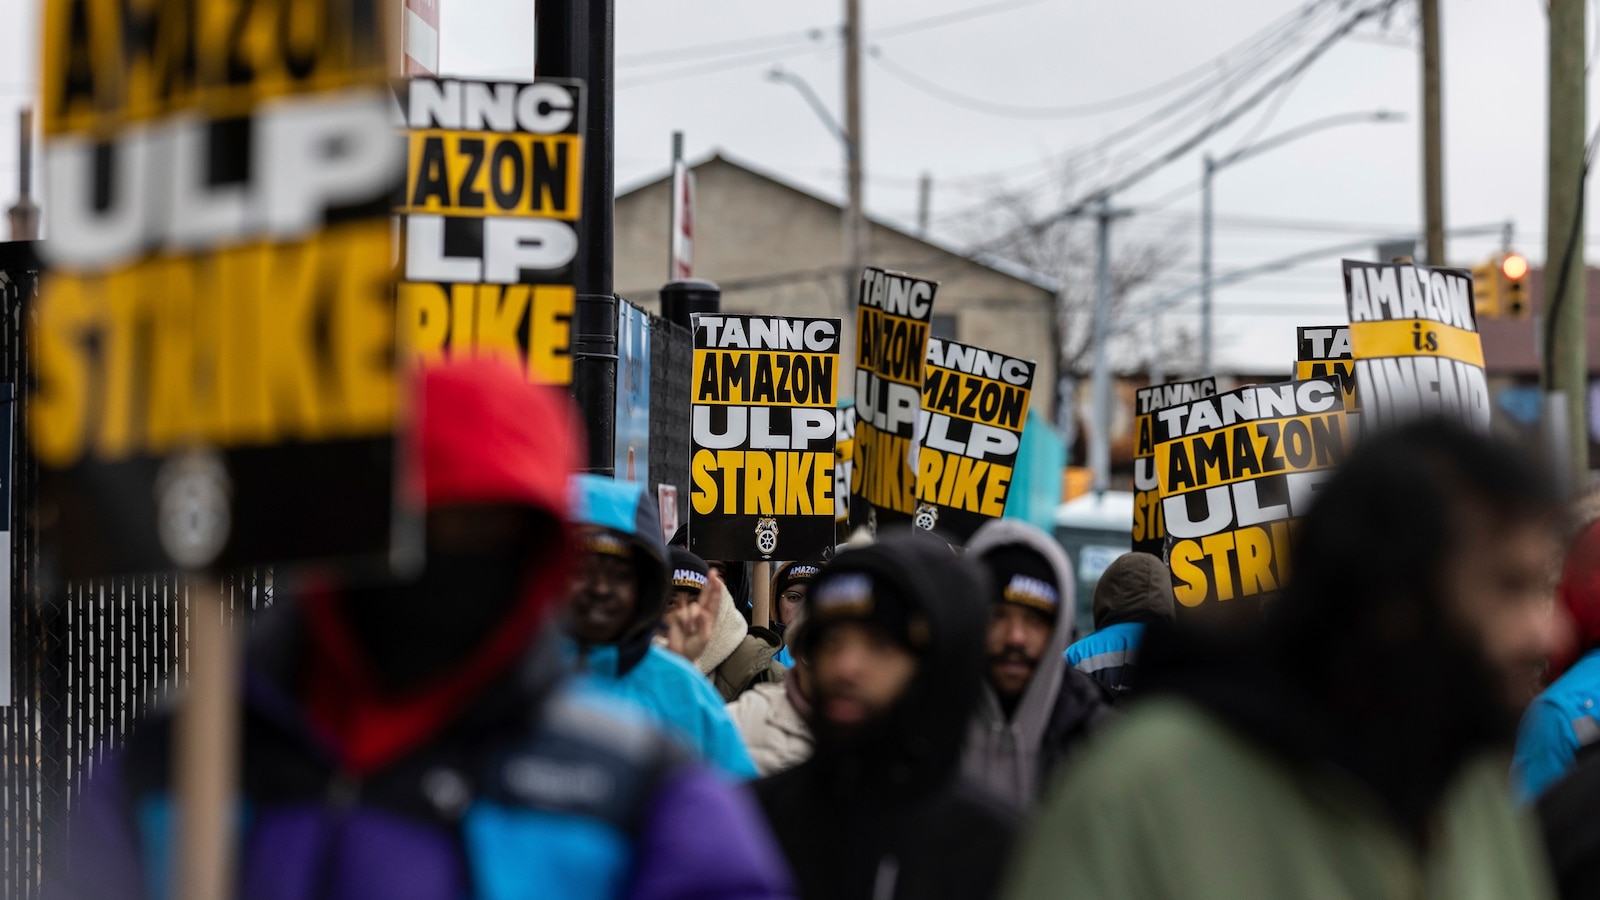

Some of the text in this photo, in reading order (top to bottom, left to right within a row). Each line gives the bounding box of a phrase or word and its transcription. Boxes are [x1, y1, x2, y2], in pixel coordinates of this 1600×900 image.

[394, 78, 574, 134] NNC
[40, 90, 403, 274] ULP
[412, 136, 570, 211] AZON
[404, 214, 578, 284] LP
[863, 269, 932, 319] TANC
[1350, 266, 1477, 332] AMAZON
[397, 282, 576, 385] RIKE
[699, 316, 836, 352] TANNC
[860, 310, 926, 382] AZON
[925, 337, 1030, 386] ANNC
[1412, 322, 1438, 352] is
[698, 352, 833, 405] AMAZON
[922, 366, 1026, 429] MAZON
[1158, 380, 1336, 438] TANNC
[692, 405, 836, 450] ULP
[920, 411, 1020, 460] LP
[1168, 416, 1345, 493] AMAZON
[691, 449, 835, 516] STRIKE
[916, 447, 1014, 519] RIKE
[673, 568, 708, 585] AMAZO
[1170, 519, 1300, 608] STRI
